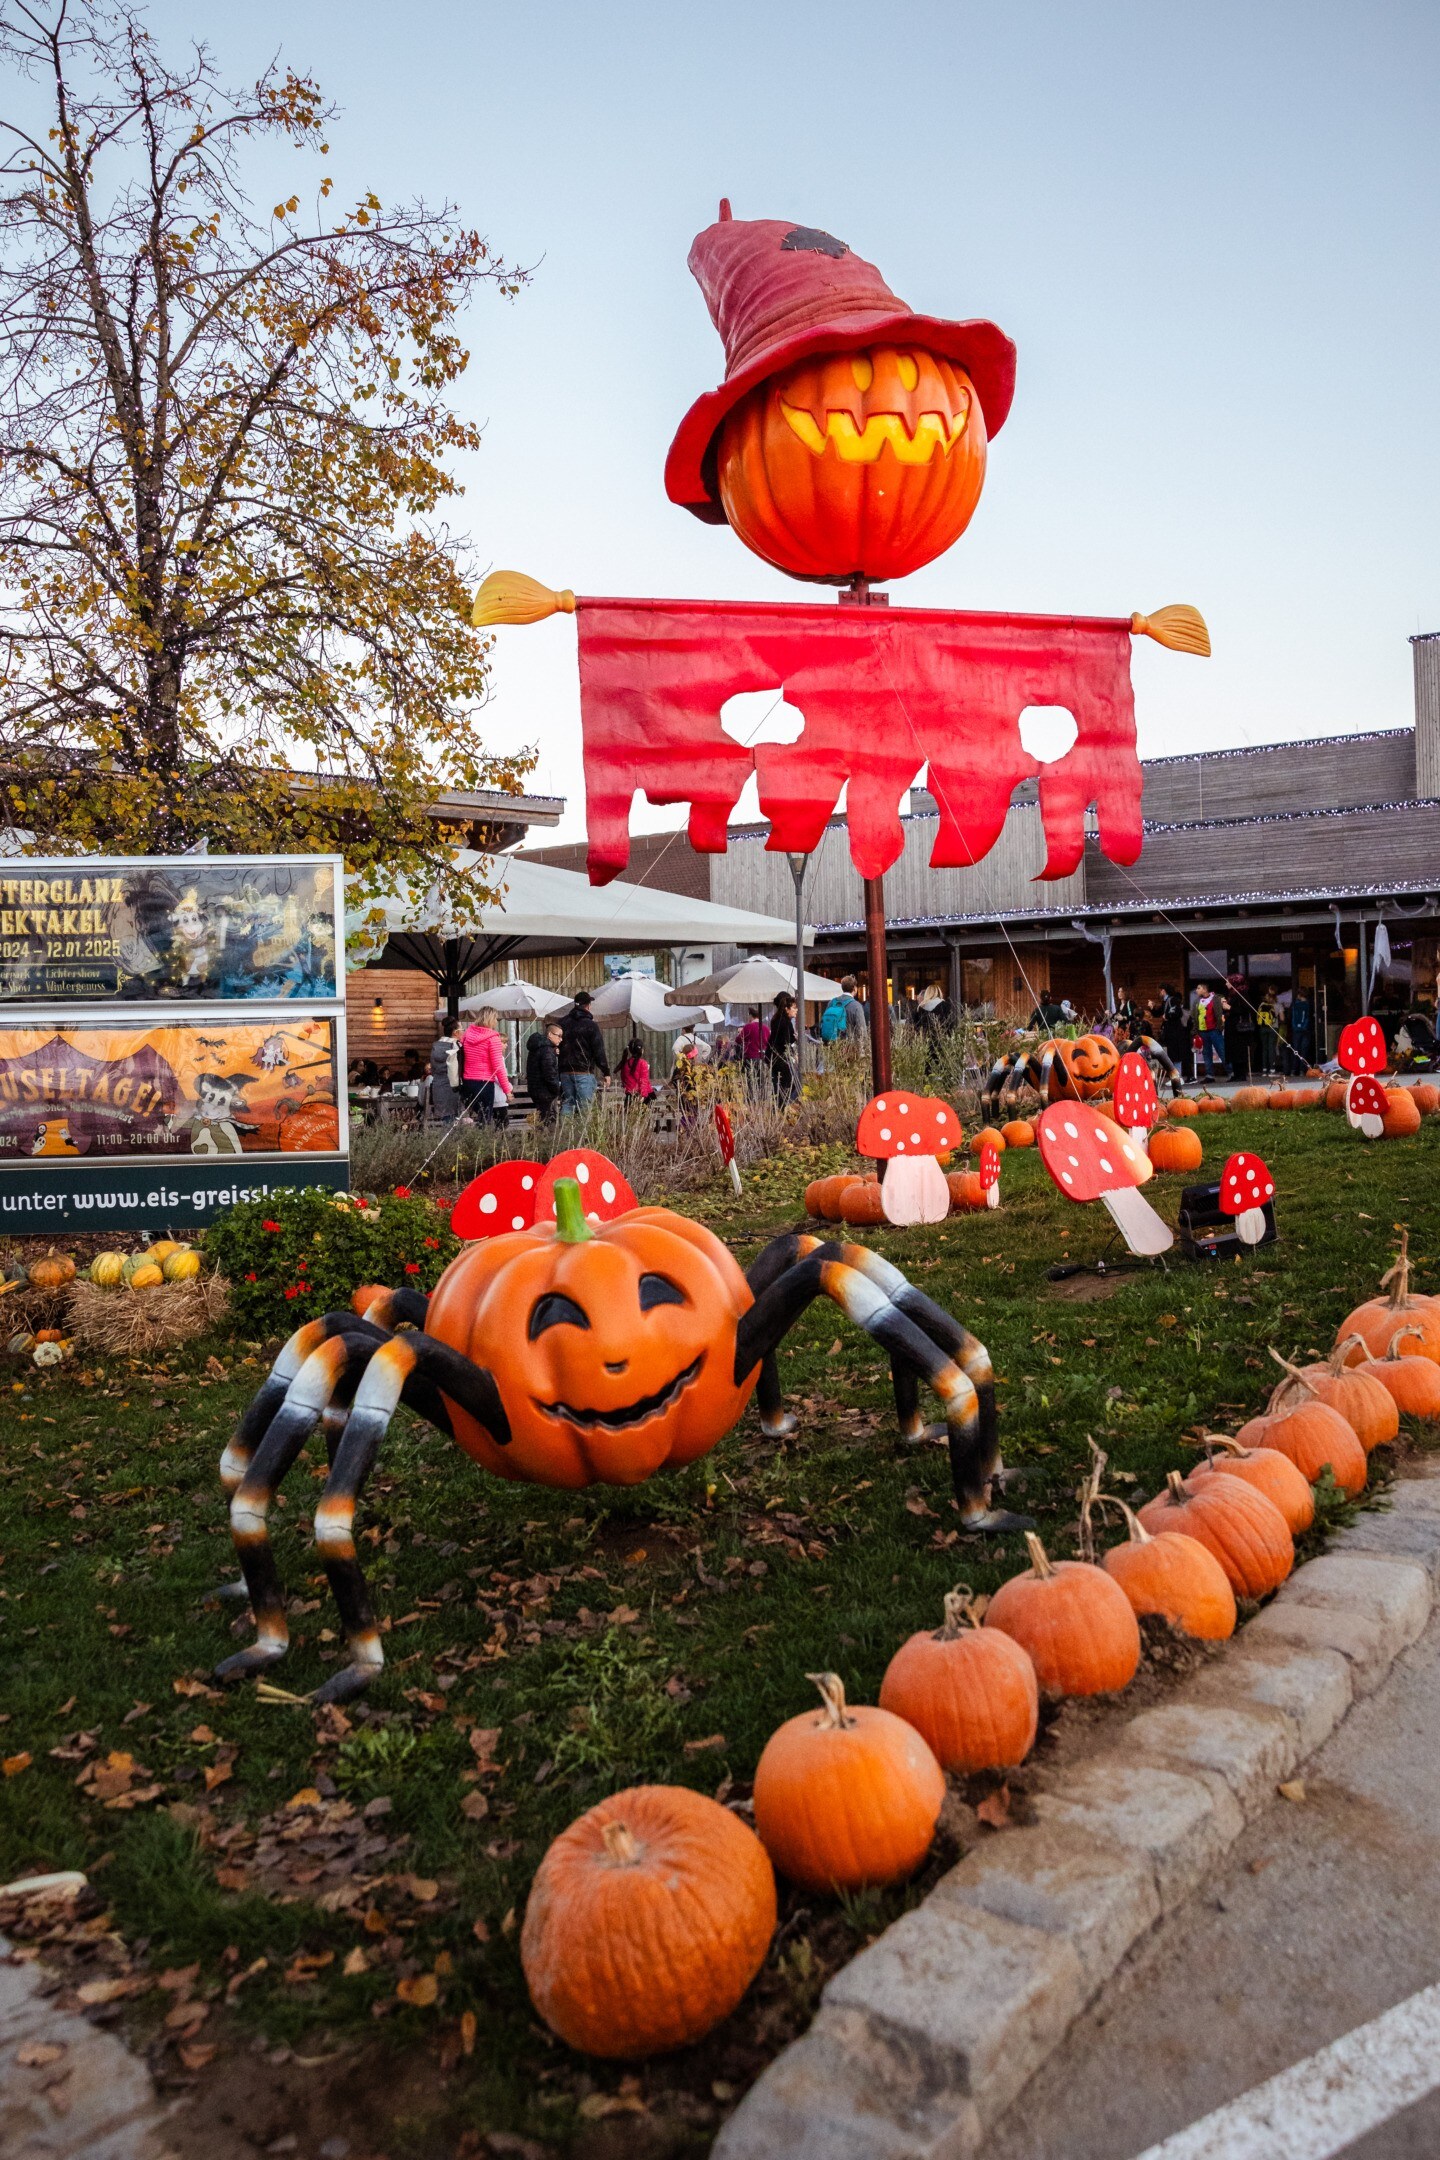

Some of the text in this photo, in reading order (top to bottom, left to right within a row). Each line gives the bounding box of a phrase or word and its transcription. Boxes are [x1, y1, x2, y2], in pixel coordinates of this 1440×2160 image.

[0, 909, 107, 935] EKTAKEL
[47, 939, 120, 958] 12.01.2025
[45, 966, 100, 979] Lichtershow
[45, 979, 106, 993] Wintergenuss
[0, 1067, 162, 1117] USELTAGE!
[0, 1136, 18, 1148] 024
[163, 1133, 181, 1144] Uhr
[2, 1192, 67, 1212] unter
